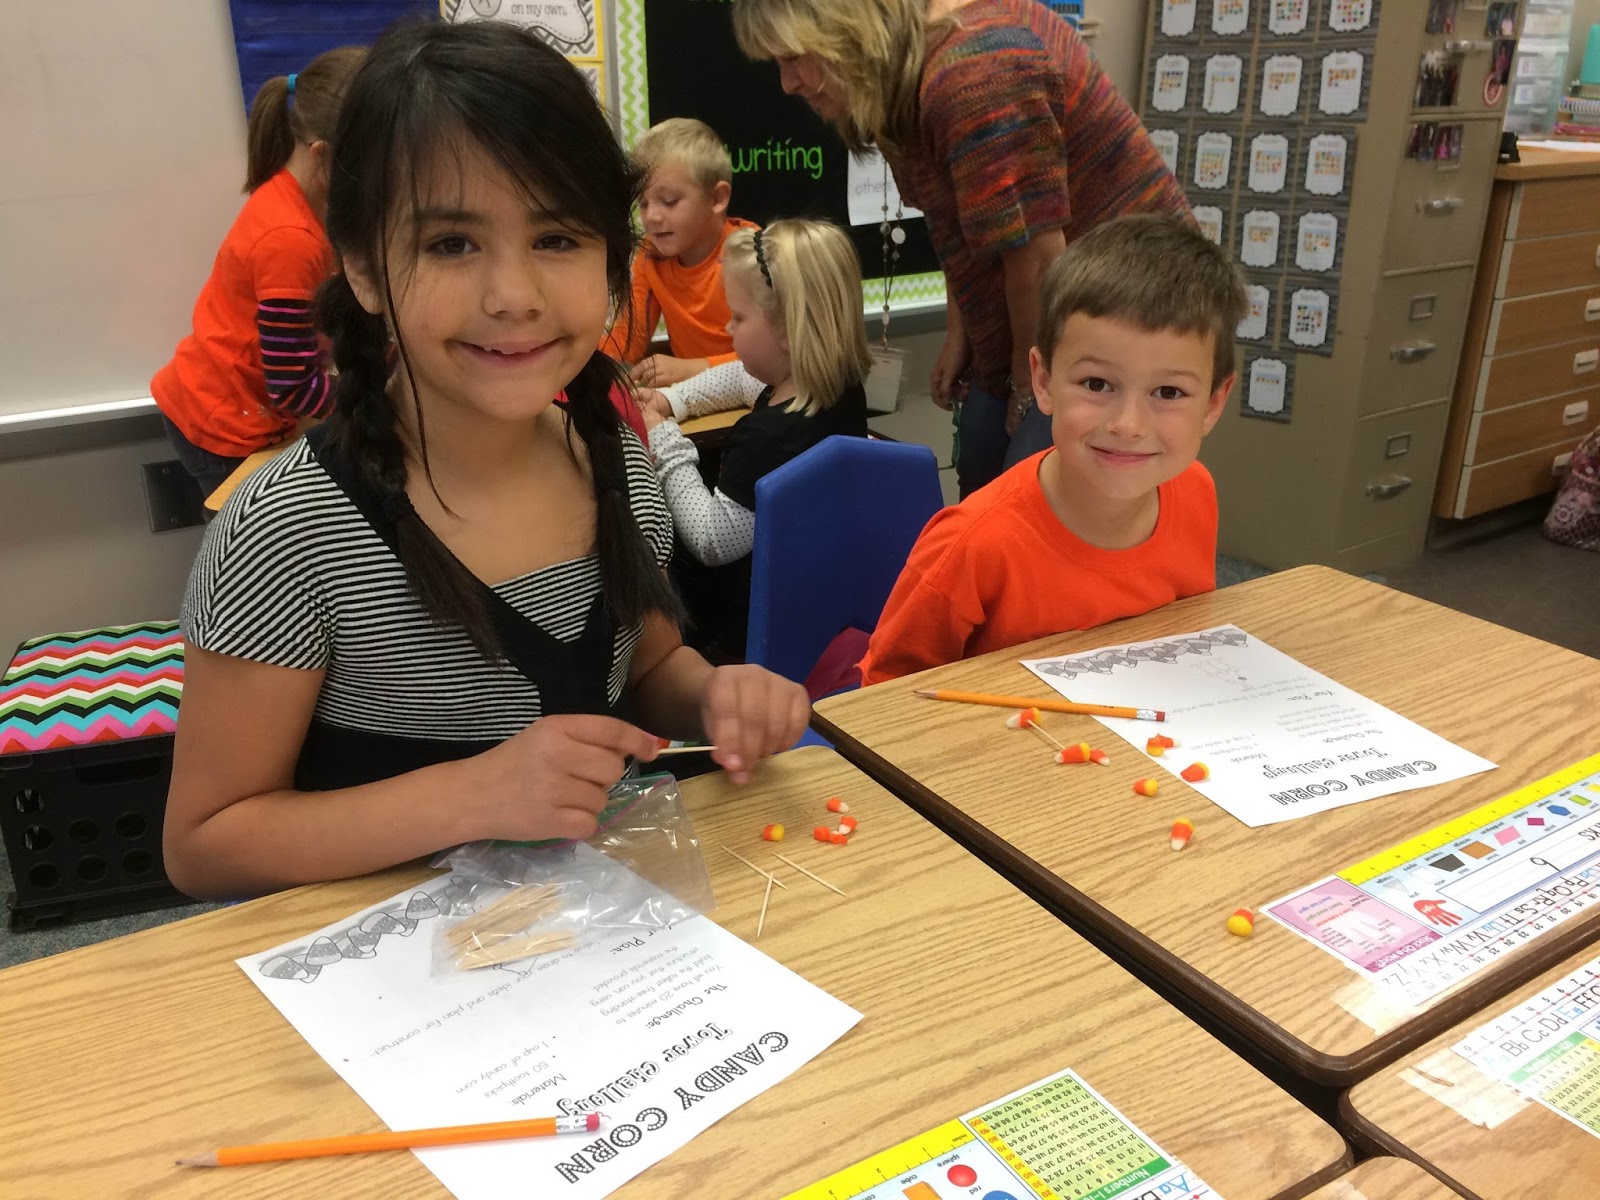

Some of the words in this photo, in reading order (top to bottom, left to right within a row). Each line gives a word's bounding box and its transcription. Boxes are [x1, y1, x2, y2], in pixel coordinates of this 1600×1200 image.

[510, 4, 525, 15] on
[526, 3, 541, 17] my
[724, 137, 823, 179] writing
[1350, 760, 1437, 787] CANDY
[1269, 780, 1348, 806] CORN
[610, 936, 646, 955] Plan:
[1503, 939, 1515, 947] 24
[1488, 947, 1500, 955] 25
[631, 974, 646, 985] you
[488, 982, 512, 995] ideas
[704, 983, 728, 995] The
[589, 993, 612, 1007] using
[659, 990, 674, 1001] 20
[466, 995, 485, 1010] and
[442, 1004, 464, 1020] plan
[645, 996, 704, 1029] Challenge:
[424, 1018, 442, 1030] for
[615, 1017, 626, 1025] to
[1499, 1039, 1530, 1057] Bb
[1521, 1029, 1550, 1043] Cc
[1538, 1012, 1569, 1032] Dd
[1573, 992, 1599, 1009] Ff
[662, 1022, 733, 1063] Tower
[523, 1045, 540, 1057] cup
[511, 1055, 522, 1067] of
[480, 1063, 508, 1080] candy
[673, 1031, 789, 1111] CANDY
[455, 1079, 478, 1094] corn
[483, 1071, 530, 1099] toothpicks
[1064, 1077, 1072, 1085] 91
[509, 1073, 567, 1106] Materials:
[556, 1061, 661, 1116] Challeng
[1044, 1086, 1053, 1094] 93
[993, 1109, 1002, 1117] 98
[1089, 1113, 1099, 1121] 52
[970, 1119, 982, 1127] 100
[991, 1122, 1000, 1130] 89
[1069, 1123, 1078, 1131] 54
[1079, 1118, 1089, 1126] 53
[980, 1127, 989, 1135] 90
[1048, 1133, 1058, 1141] 56
[554, 1107, 668, 1184] CORN
[1027, 1143, 1037, 1151] 58
[1037, 1138, 1047, 1146] 57
[1005, 1153, 1015, 1161] 60
[1016, 1148, 1026, 1156] 59
[937, 1154, 960, 1168] sphere
[900, 1174, 918, 1185] cube
[1103, 1168, 1151, 1194] Numbers
[1158, 1174, 1190, 1195] Aa
[968, 1185, 982, 1195] red
